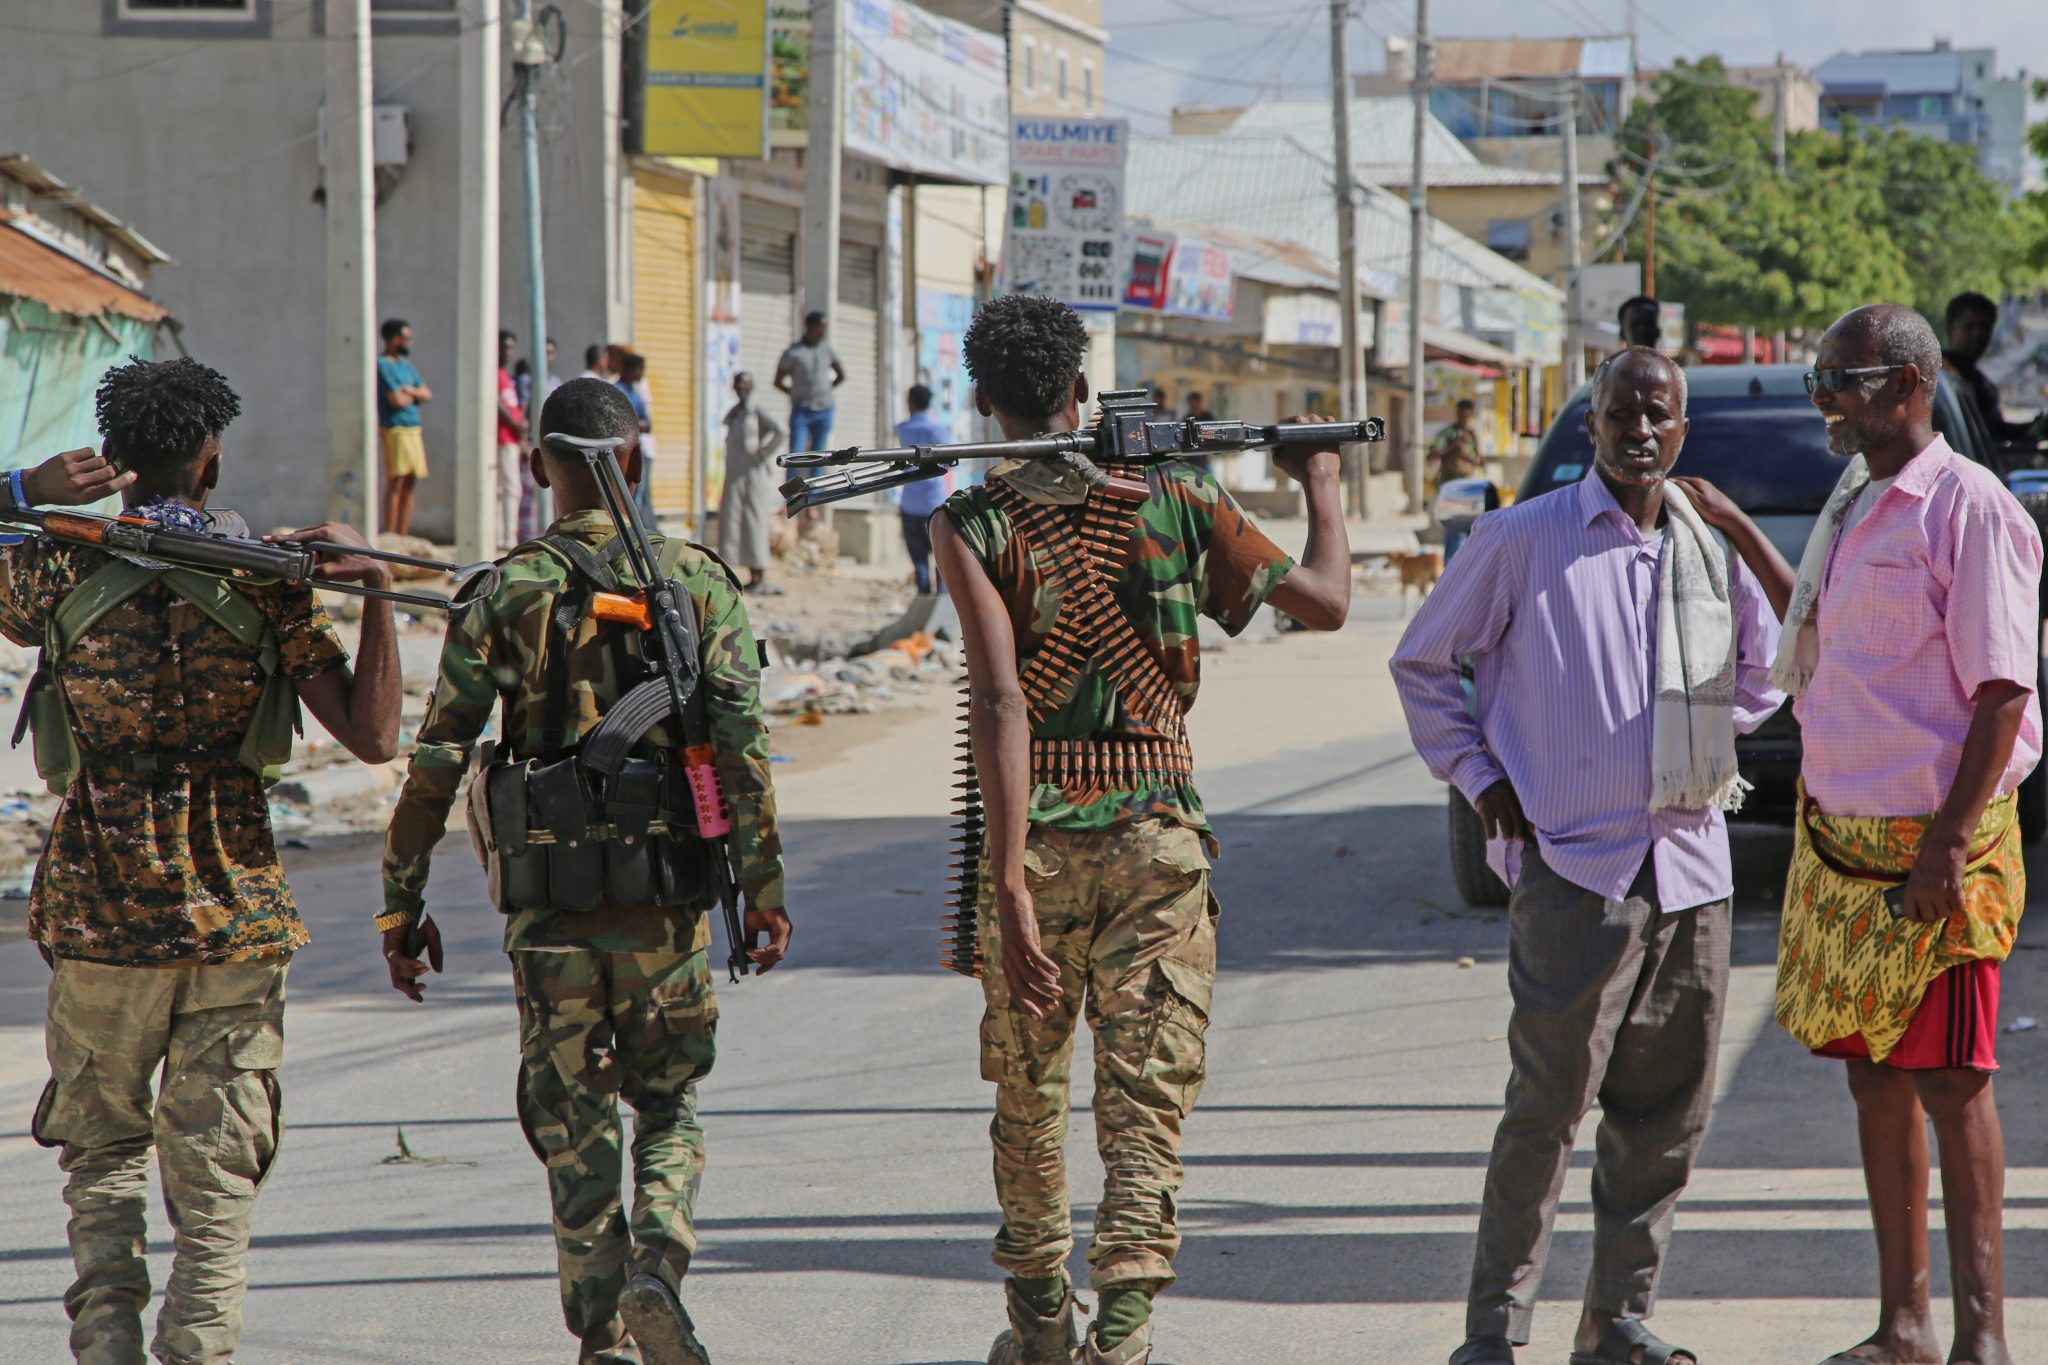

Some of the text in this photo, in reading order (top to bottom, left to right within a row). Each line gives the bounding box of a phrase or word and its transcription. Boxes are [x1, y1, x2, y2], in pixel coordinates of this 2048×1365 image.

[1016, 123, 1117, 144] KULMIYE
[1017, 143, 1118, 161] SPARE PARTS
